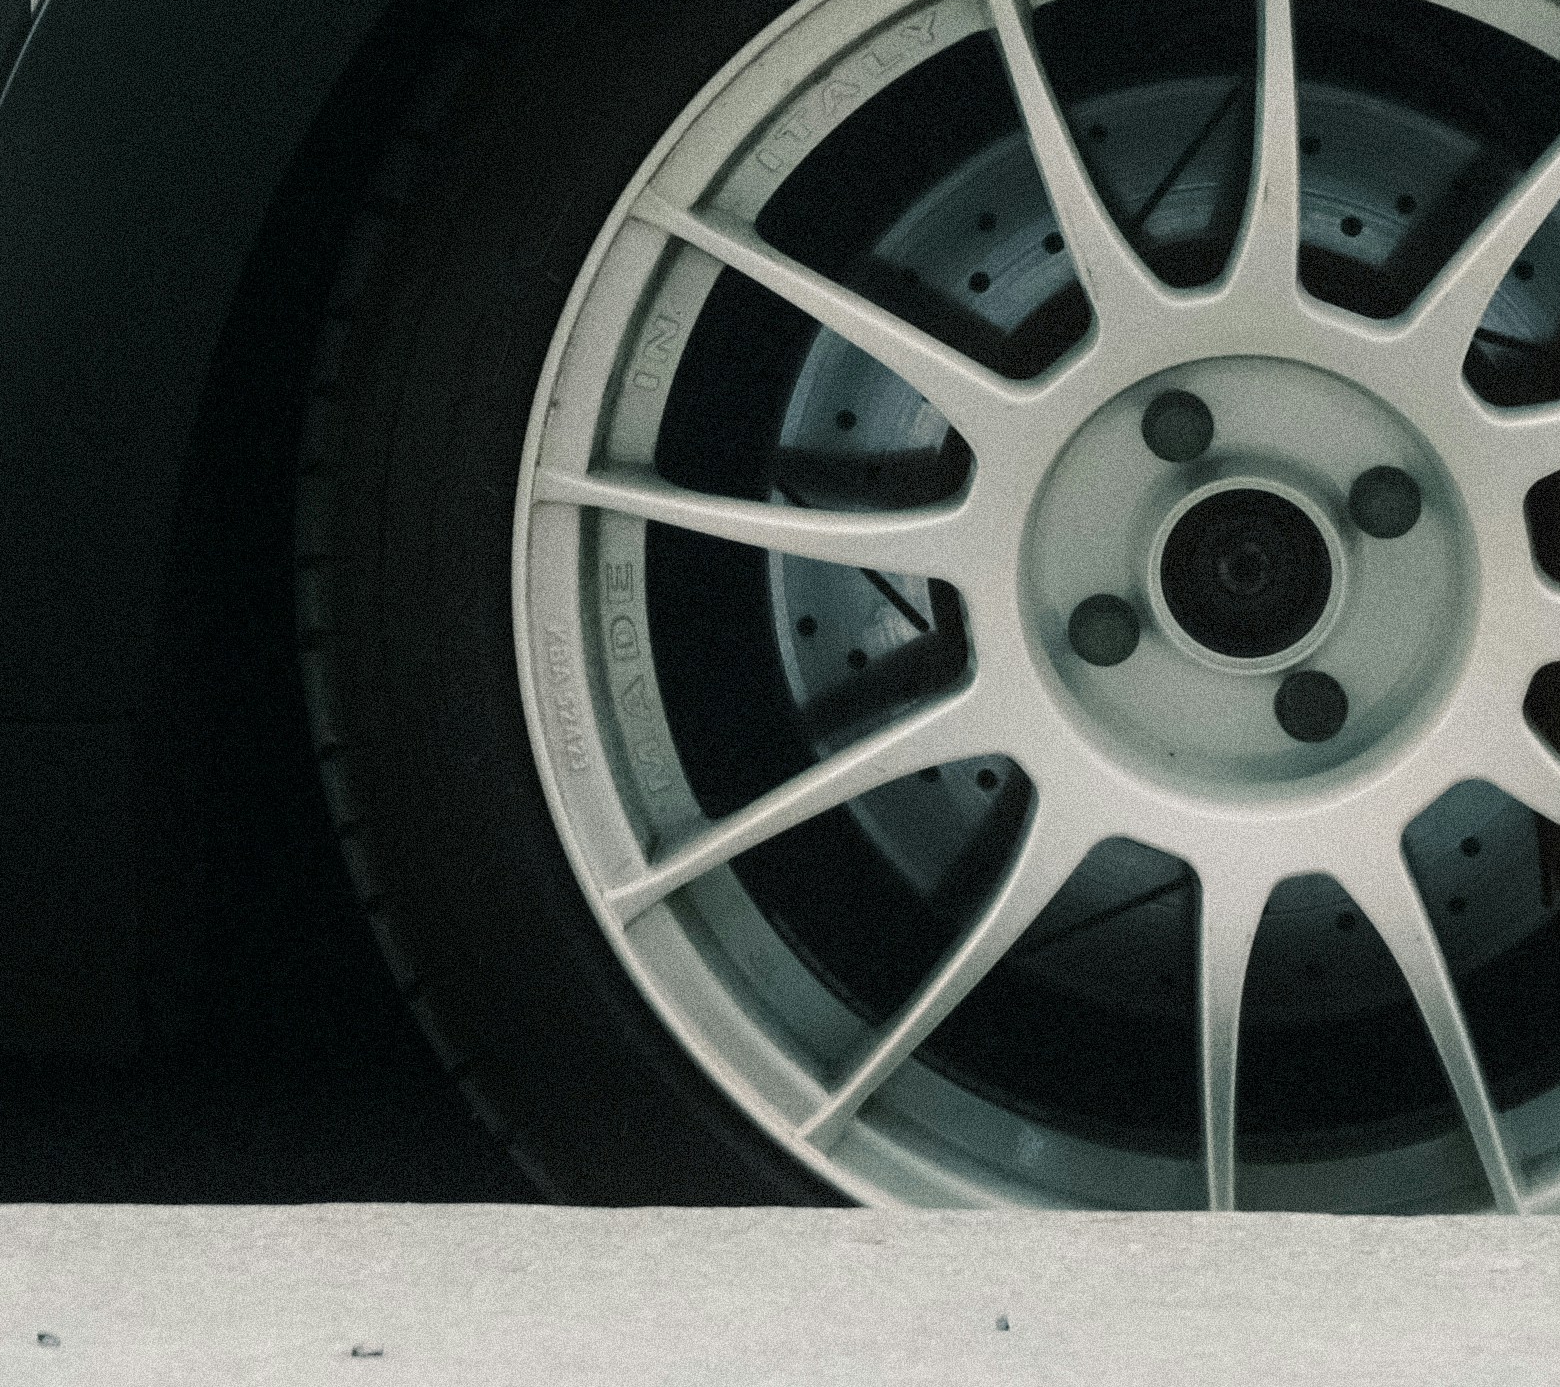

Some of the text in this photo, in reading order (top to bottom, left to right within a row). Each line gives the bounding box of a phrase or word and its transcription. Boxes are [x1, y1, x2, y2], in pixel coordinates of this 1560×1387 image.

[602, 9, 940, 795] MADE IN ITALY
